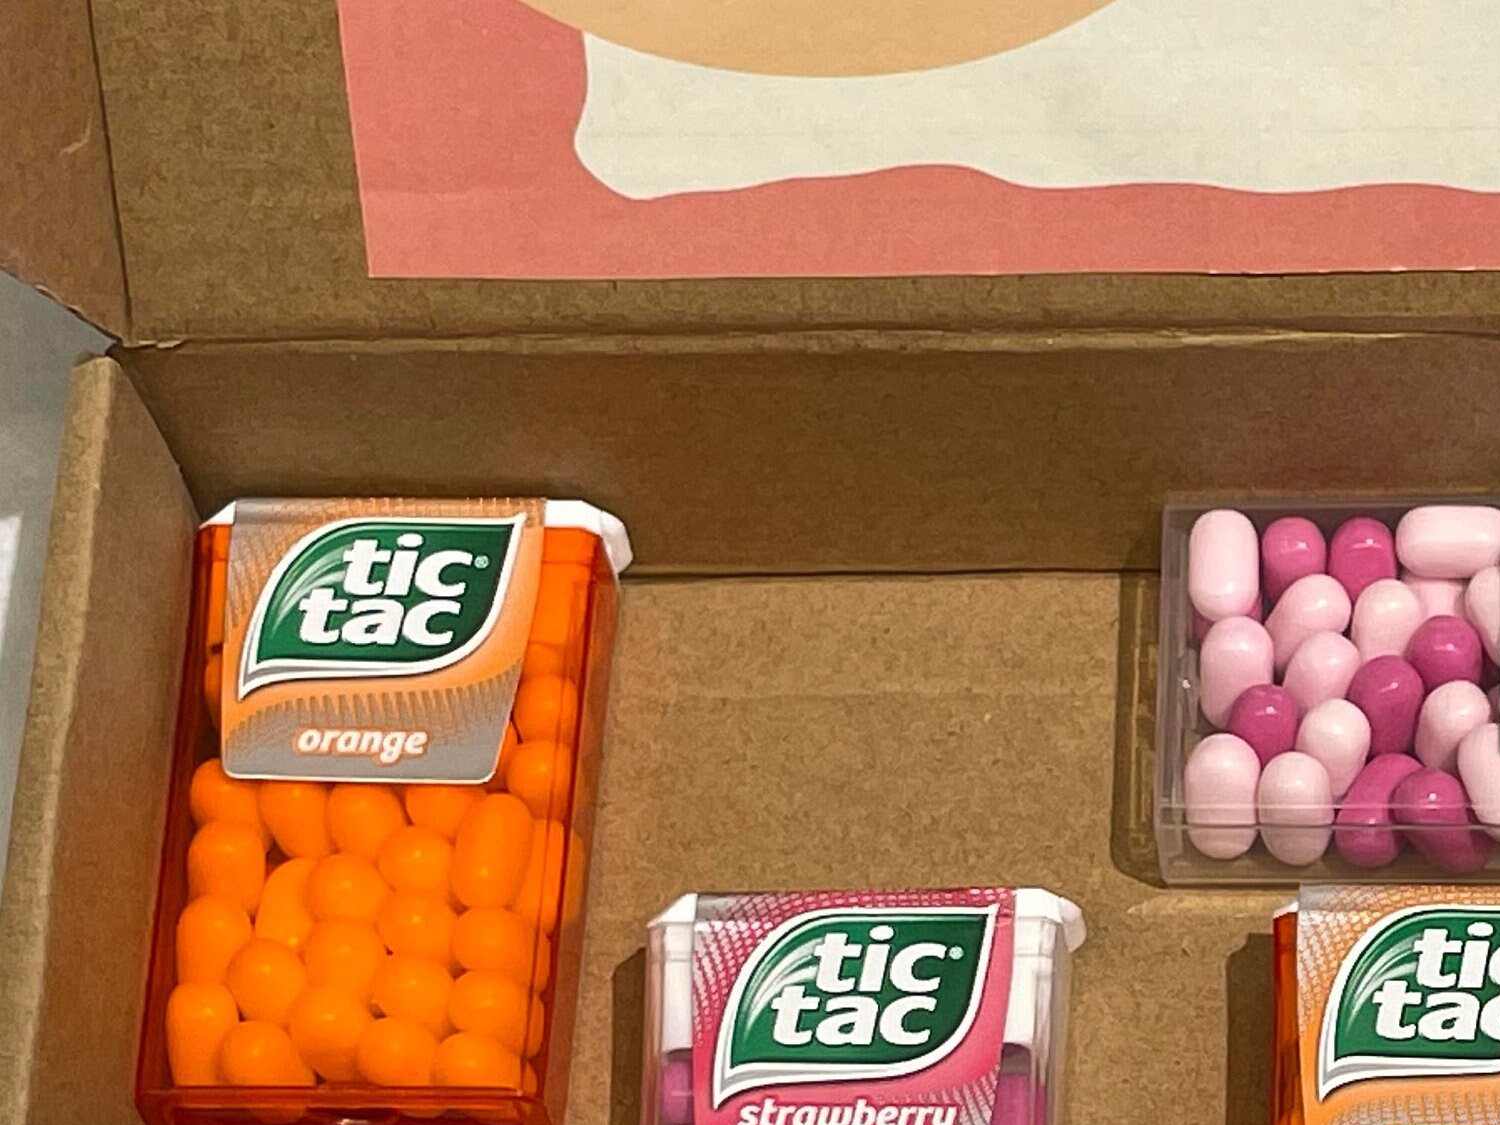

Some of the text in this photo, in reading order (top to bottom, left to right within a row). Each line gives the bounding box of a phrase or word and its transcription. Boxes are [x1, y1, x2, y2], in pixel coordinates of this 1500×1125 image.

[343, 534, 472, 597] tic
[299, 589, 460, 646] tac
[298, 728, 427, 763] orange
[814, 925, 947, 993] tic
[772, 986, 936, 1046] tac
